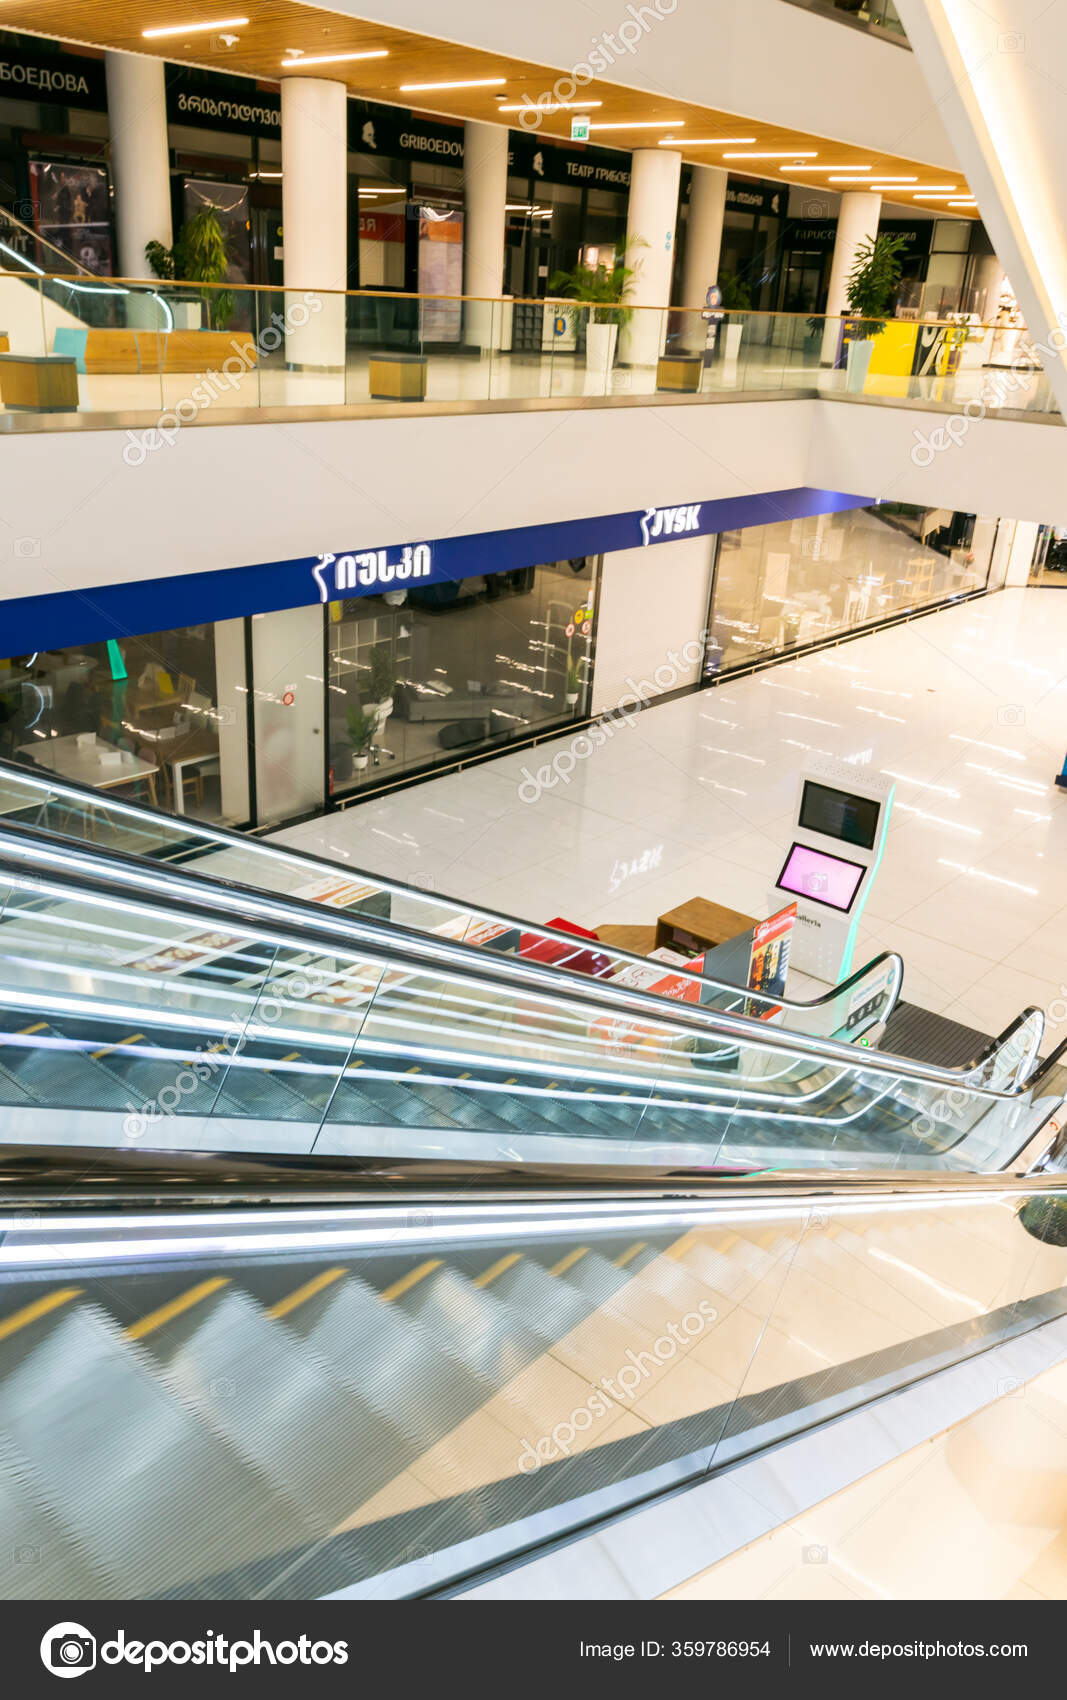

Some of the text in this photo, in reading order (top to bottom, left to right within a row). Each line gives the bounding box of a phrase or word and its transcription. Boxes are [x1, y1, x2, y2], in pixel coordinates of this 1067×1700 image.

[178, 93, 282, 126] გრიბოედოვი
[566, 161, 594, 179] ТЕАТР
[650, 504, 702, 537] JYSK
